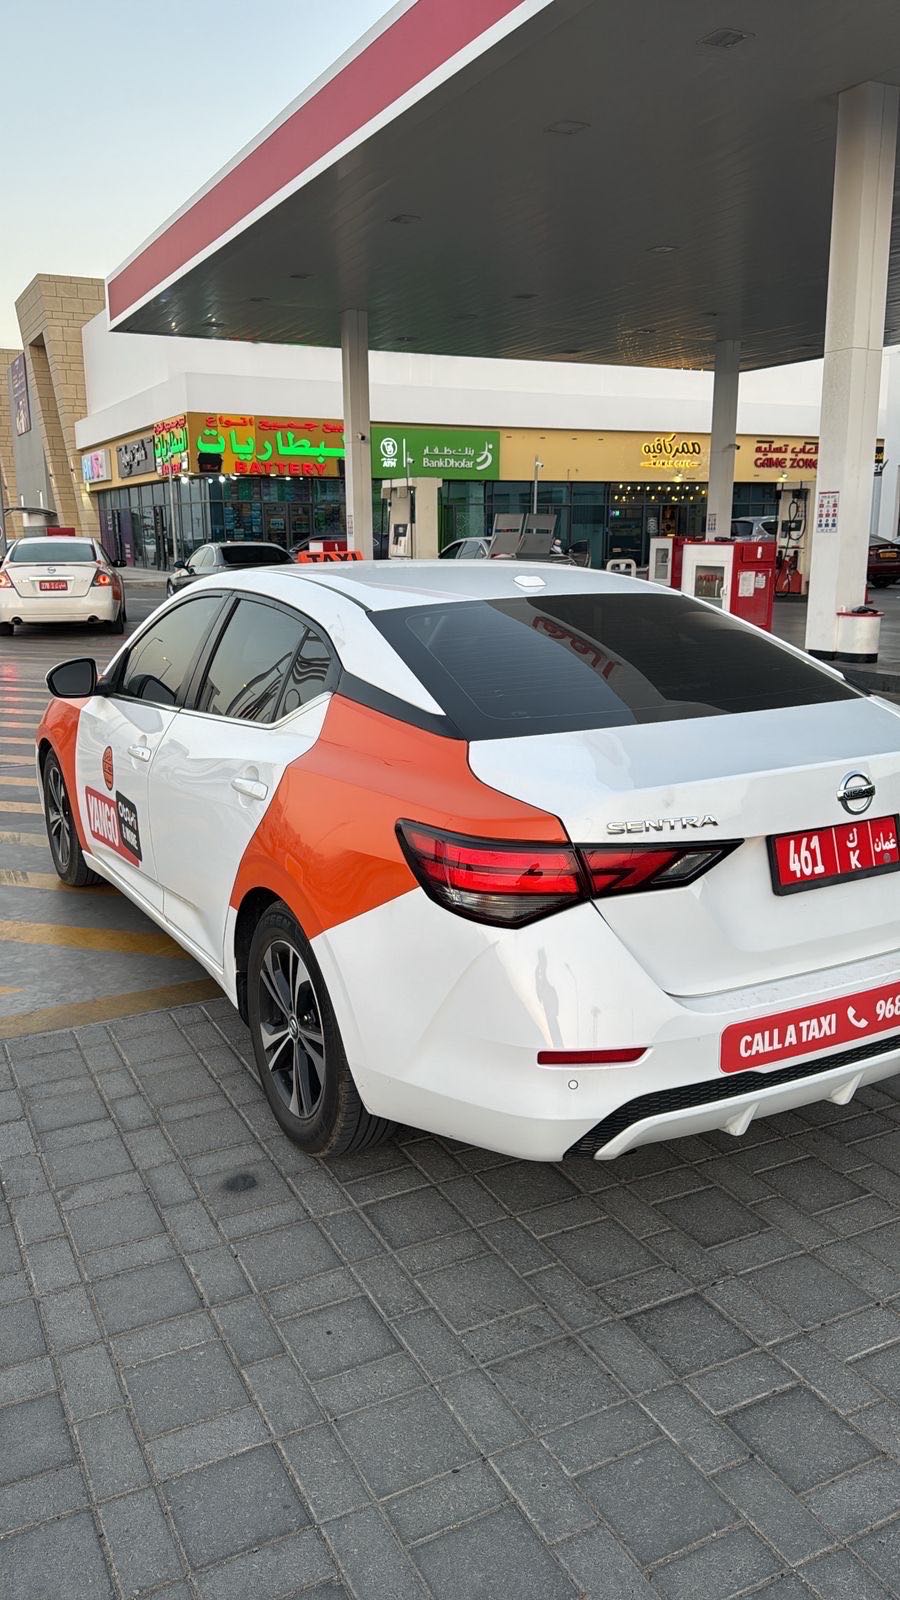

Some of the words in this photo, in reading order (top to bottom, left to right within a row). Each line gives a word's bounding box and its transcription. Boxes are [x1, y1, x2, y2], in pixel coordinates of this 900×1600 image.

[235, 461, 327, 476] BATTERY
[423, 457, 474, 468] BankDhofar
[754, 457, 787, 469] GAME
[844, 786, 875, 799] NISSAN
[87, 793, 119, 847] YANGO
[606, 814, 719, 835] SENTRA
[789, 835, 825, 878] 461
[849, 849, 862, 869] K
[739, 1026, 783, 1058] CALL
[784, 1024, 797, 1047] A
[799, 1013, 837, 1043] TAXI
